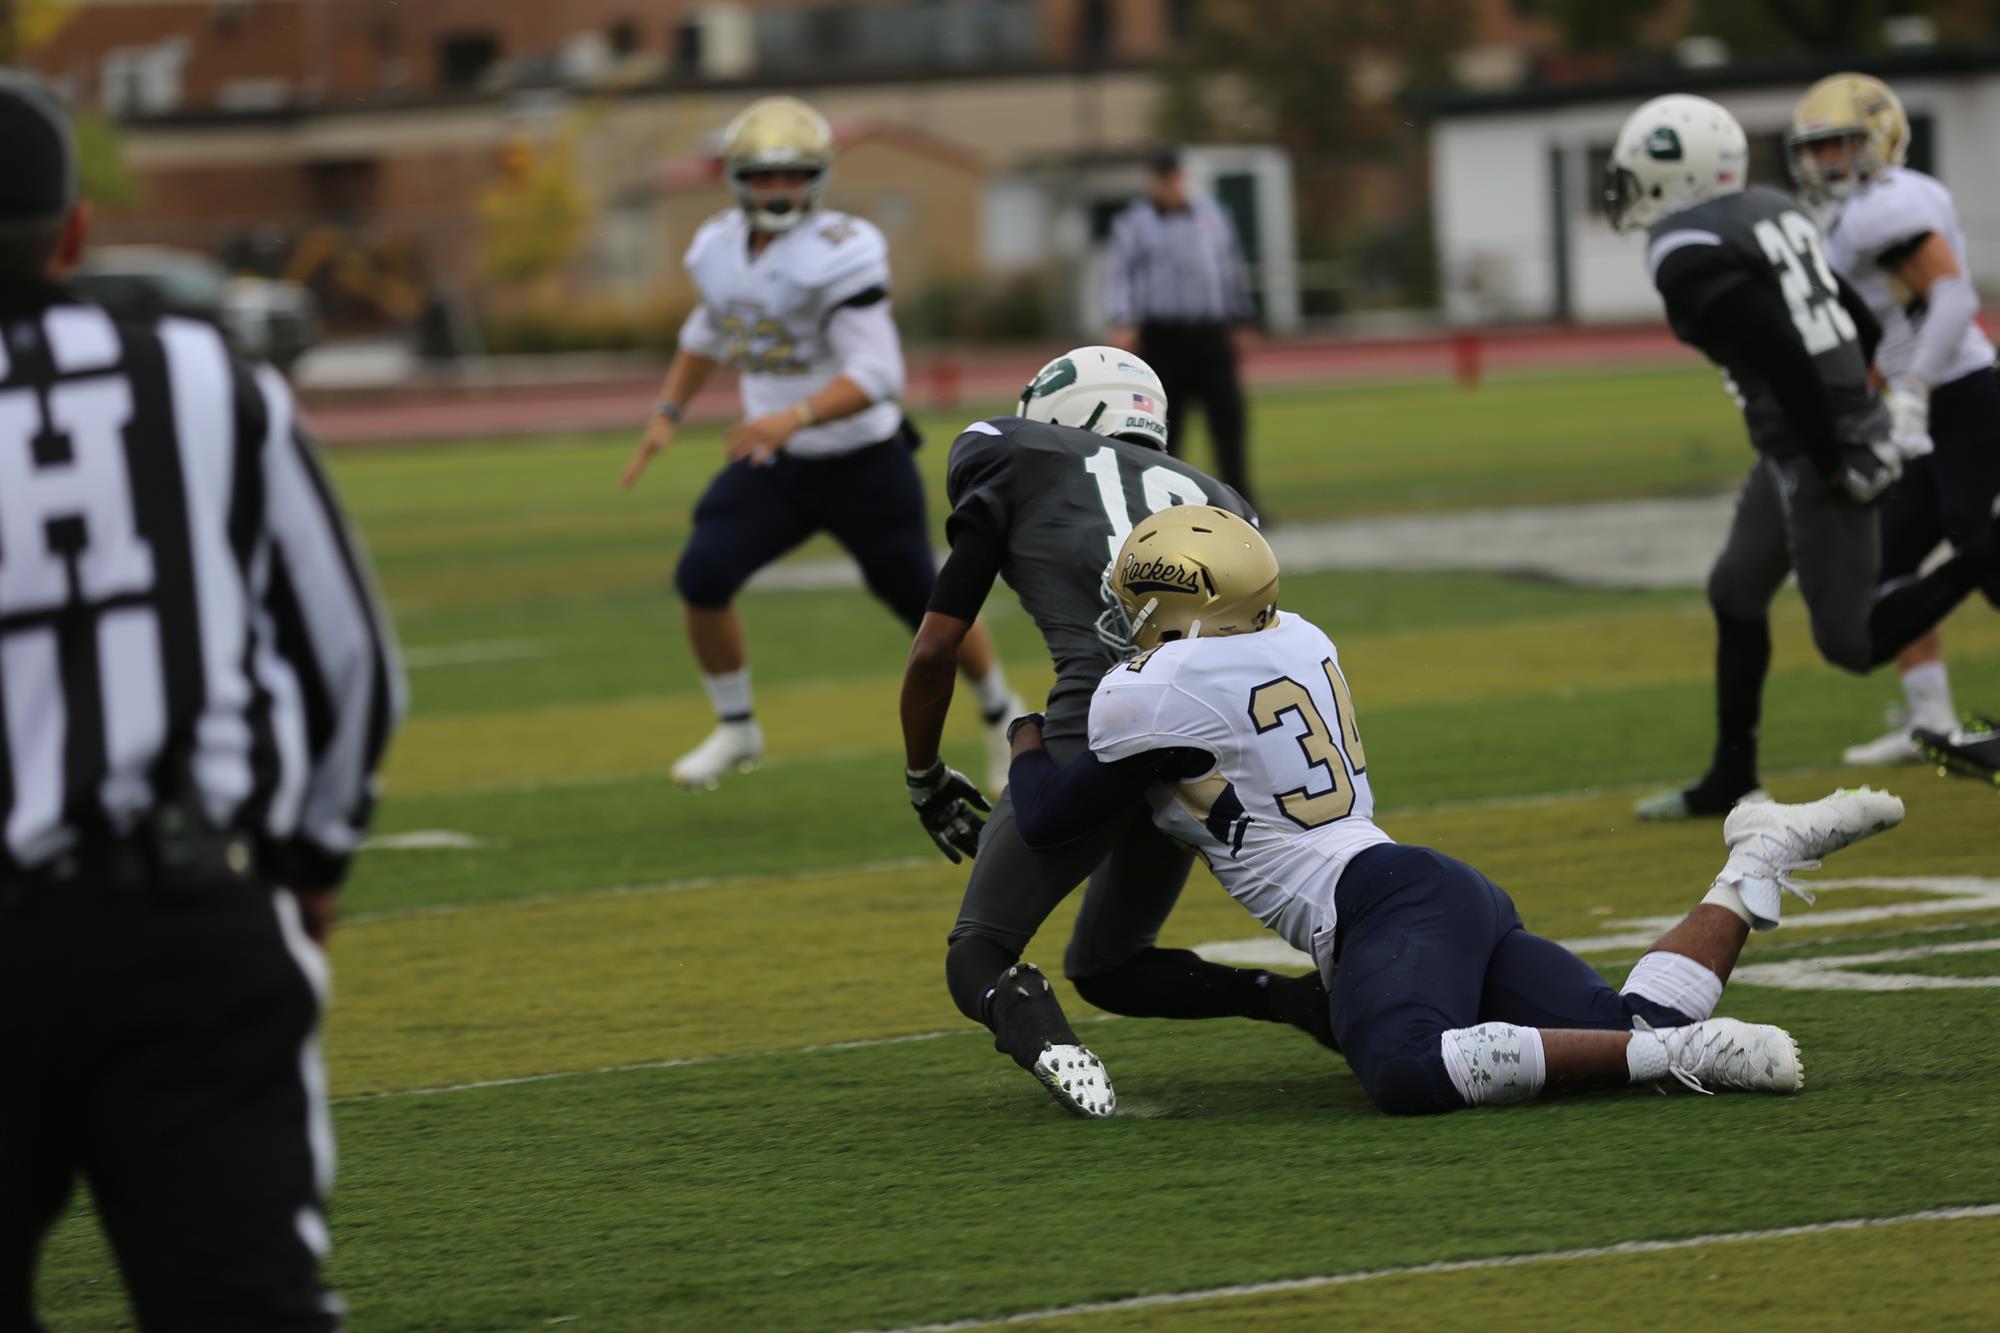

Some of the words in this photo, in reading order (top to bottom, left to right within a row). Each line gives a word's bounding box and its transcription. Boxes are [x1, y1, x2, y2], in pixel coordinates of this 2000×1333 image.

[1754, 210, 1858, 356] 23
[0, 374, 155, 605] H
[1126, 416, 1145, 428] OLD
[1119, 552, 1199, 588] Rockers
[1248, 655, 1366, 831] 34
